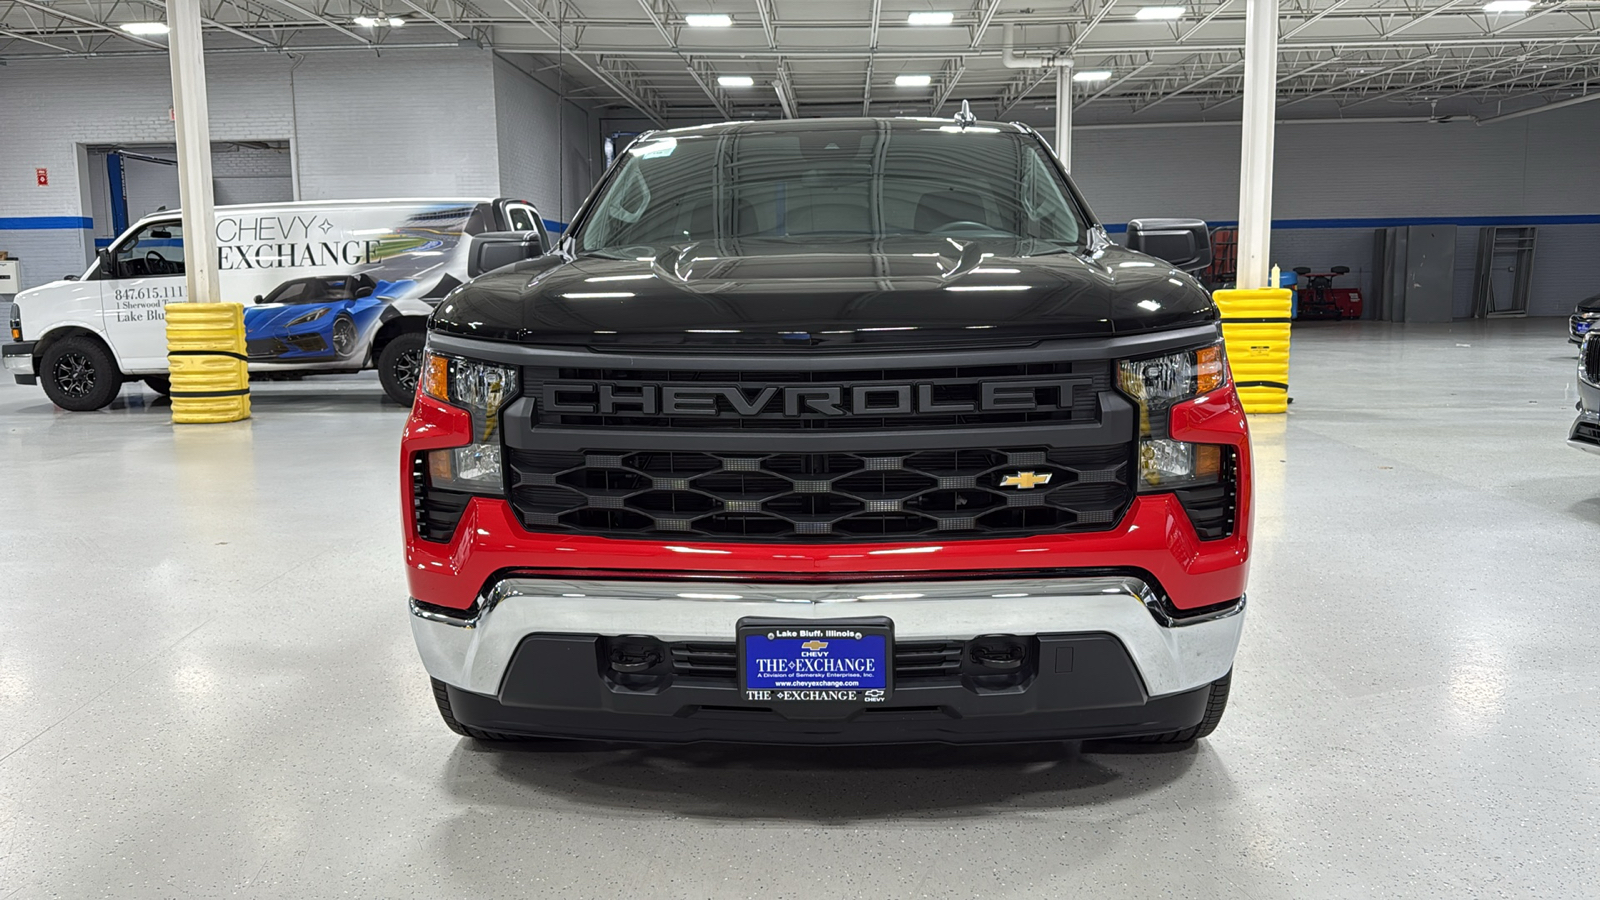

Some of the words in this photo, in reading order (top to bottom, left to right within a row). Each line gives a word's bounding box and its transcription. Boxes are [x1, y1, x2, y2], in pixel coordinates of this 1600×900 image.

[215, 215, 317, 243] CHEVY
[217, 239, 382, 271] EXCHANGE
[122, 299, 161, 309] Sherwood
[117, 310, 143, 322] Lake
[146, 309, 168, 321] Blu
[543, 377, 1093, 417] CHEVROLET
[756, 658, 788, 672] THE
[795, 658, 875, 672] EXCHANGE
[746, 690, 771, 700] THE
[783, 690, 857, 700] EXCHANGE
